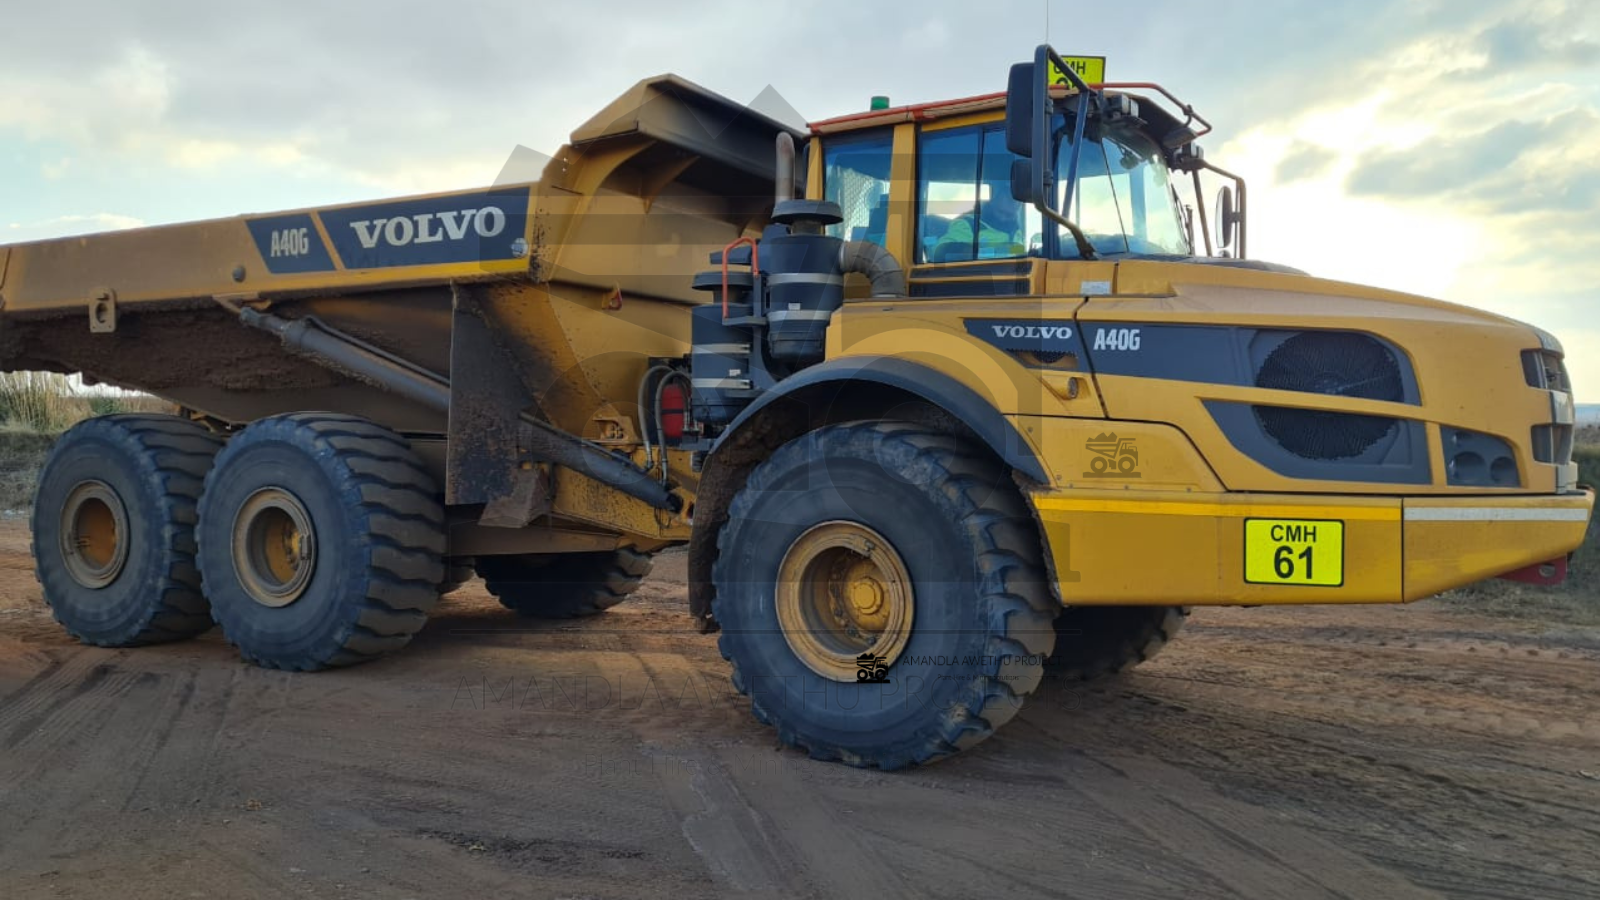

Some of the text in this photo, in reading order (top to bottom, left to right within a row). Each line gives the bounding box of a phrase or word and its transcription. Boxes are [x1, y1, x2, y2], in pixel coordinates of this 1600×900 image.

[350, 206, 506, 249] VOLVO
[270, 228, 309, 257] A40G
[992, 325, 1073, 339] VOLVO
[1093, 328, 1141, 351] A40G
[1270, 524, 1317, 543] CMH
[1273, 545, 1313, 580] 61
